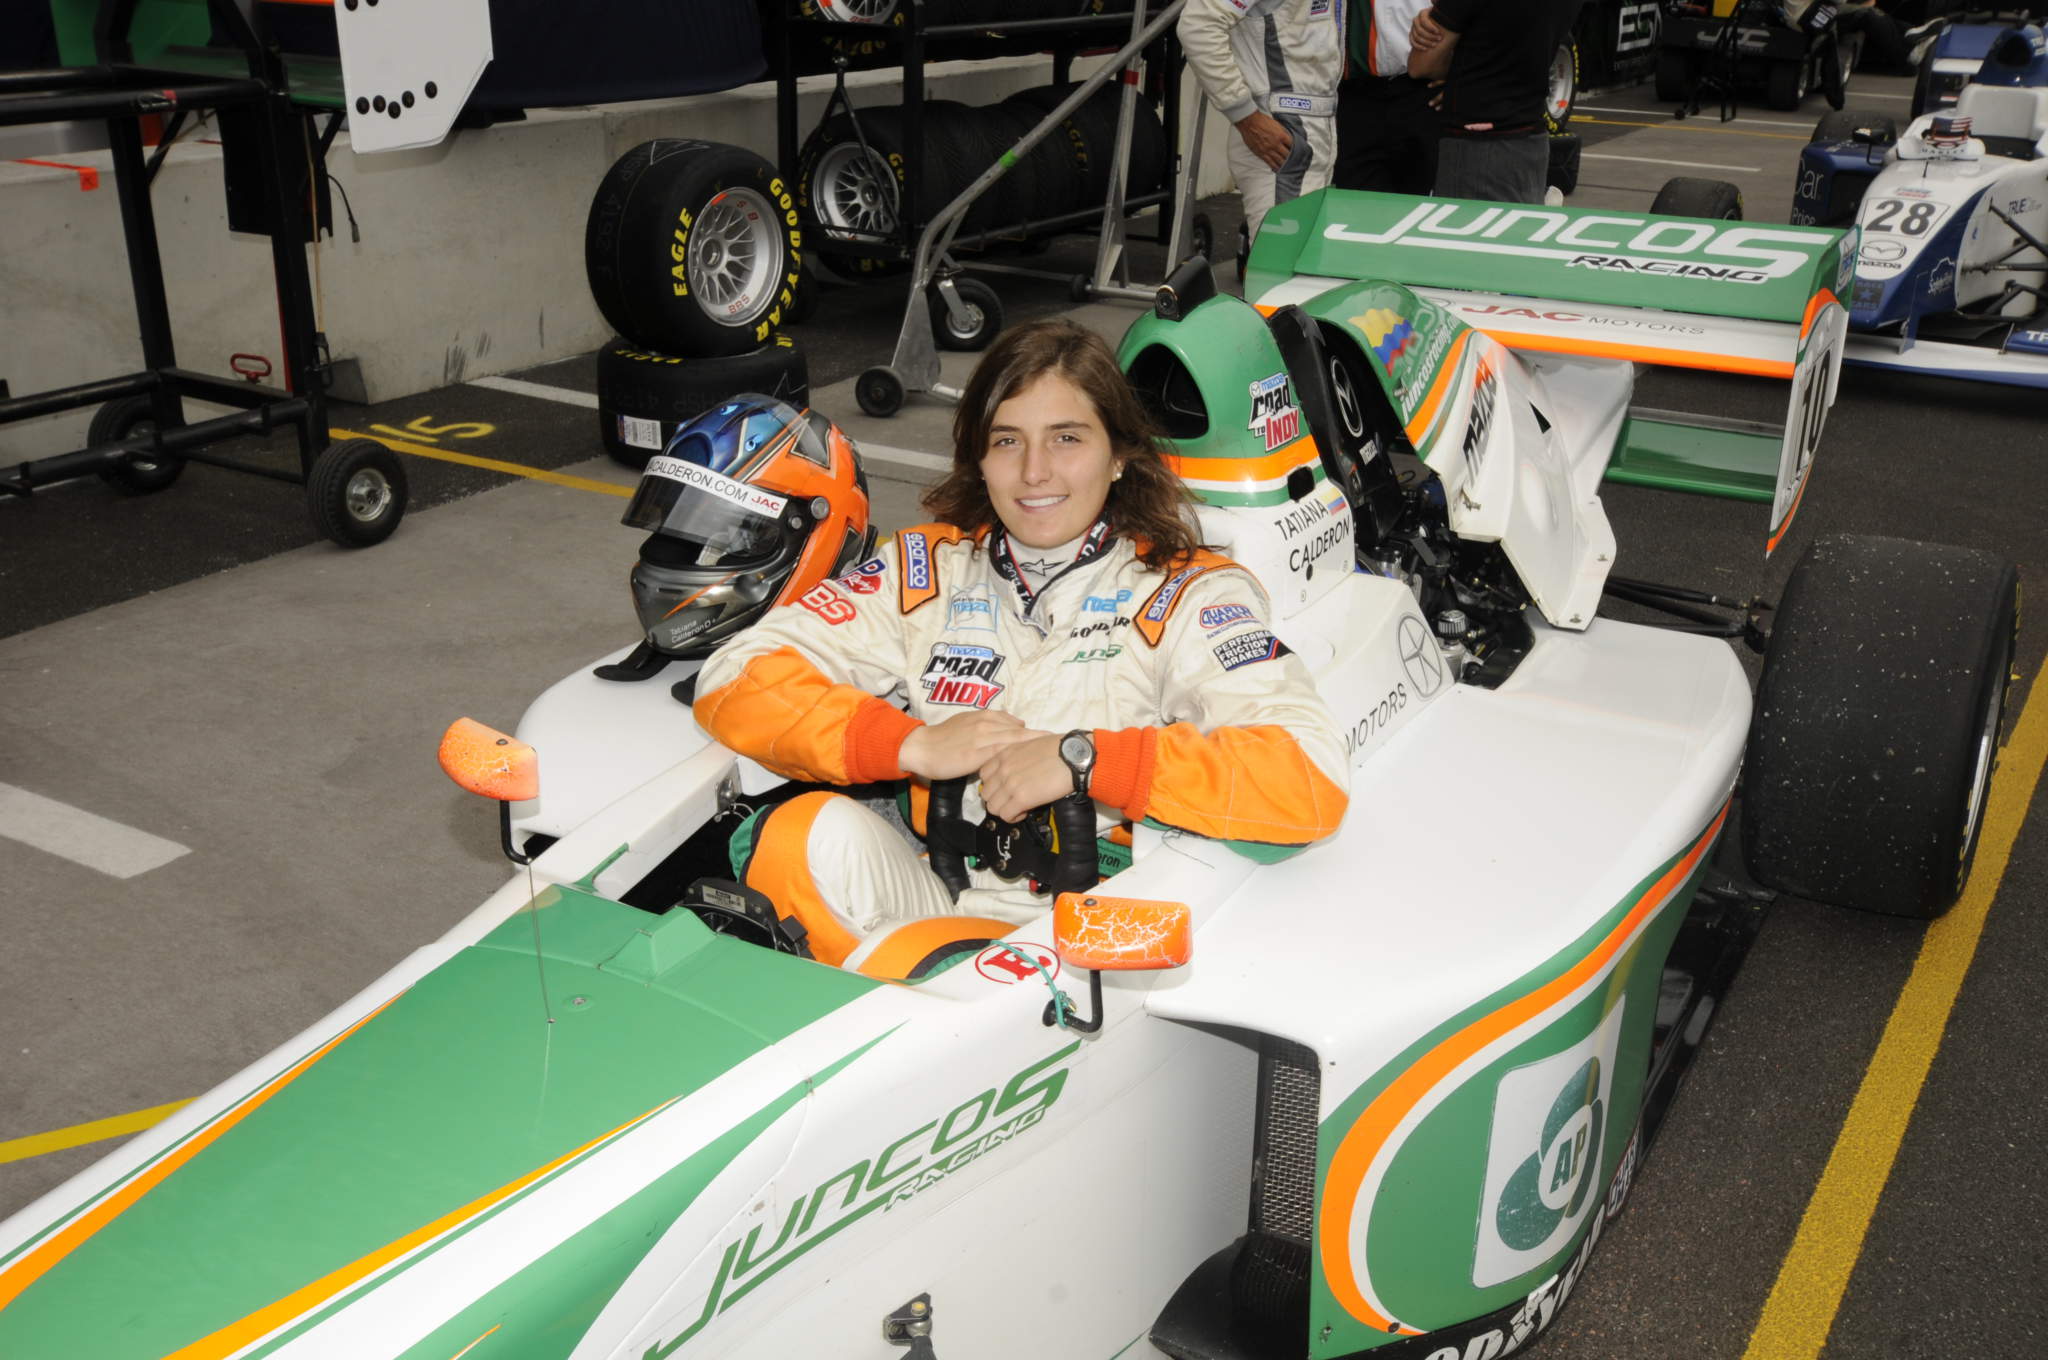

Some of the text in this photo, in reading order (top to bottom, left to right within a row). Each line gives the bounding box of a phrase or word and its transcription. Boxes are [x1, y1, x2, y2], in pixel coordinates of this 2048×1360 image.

[1865, 200, 1936, 236] 28
[671, 207, 693, 296] EAGLE
[1323, 203, 1835, 277] JUNCOS
[756, 177, 801, 342] GOODYEAR
[1573, 255, 1768, 282] RACING
[728, 294, 751, 314] BBS
[1462, 305, 1706, 335] JAC MOTORS
[1262, 374, 1285, 392] mazda
[1253, 386, 1291, 419] road
[369, 415, 497, 443] 15
[1266, 410, 1300, 450] INDY
[752, 495, 781, 512] JAC
[1273, 498, 1329, 541] TATIANA
[1289, 514, 1350, 572] CALDERON
[905, 533, 927, 588] sparco
[1219, 639, 1269, 662] FRICTION
[1223, 647, 1267, 669] BRAKES
[926, 655, 1001, 682] road
[930, 676, 1000, 708] INDY
[883, 1103, 1047, 1212] RACING
[1549, 1122, 1588, 1194] AP
[641, 1038, 1086, 1360] JUNCOS
